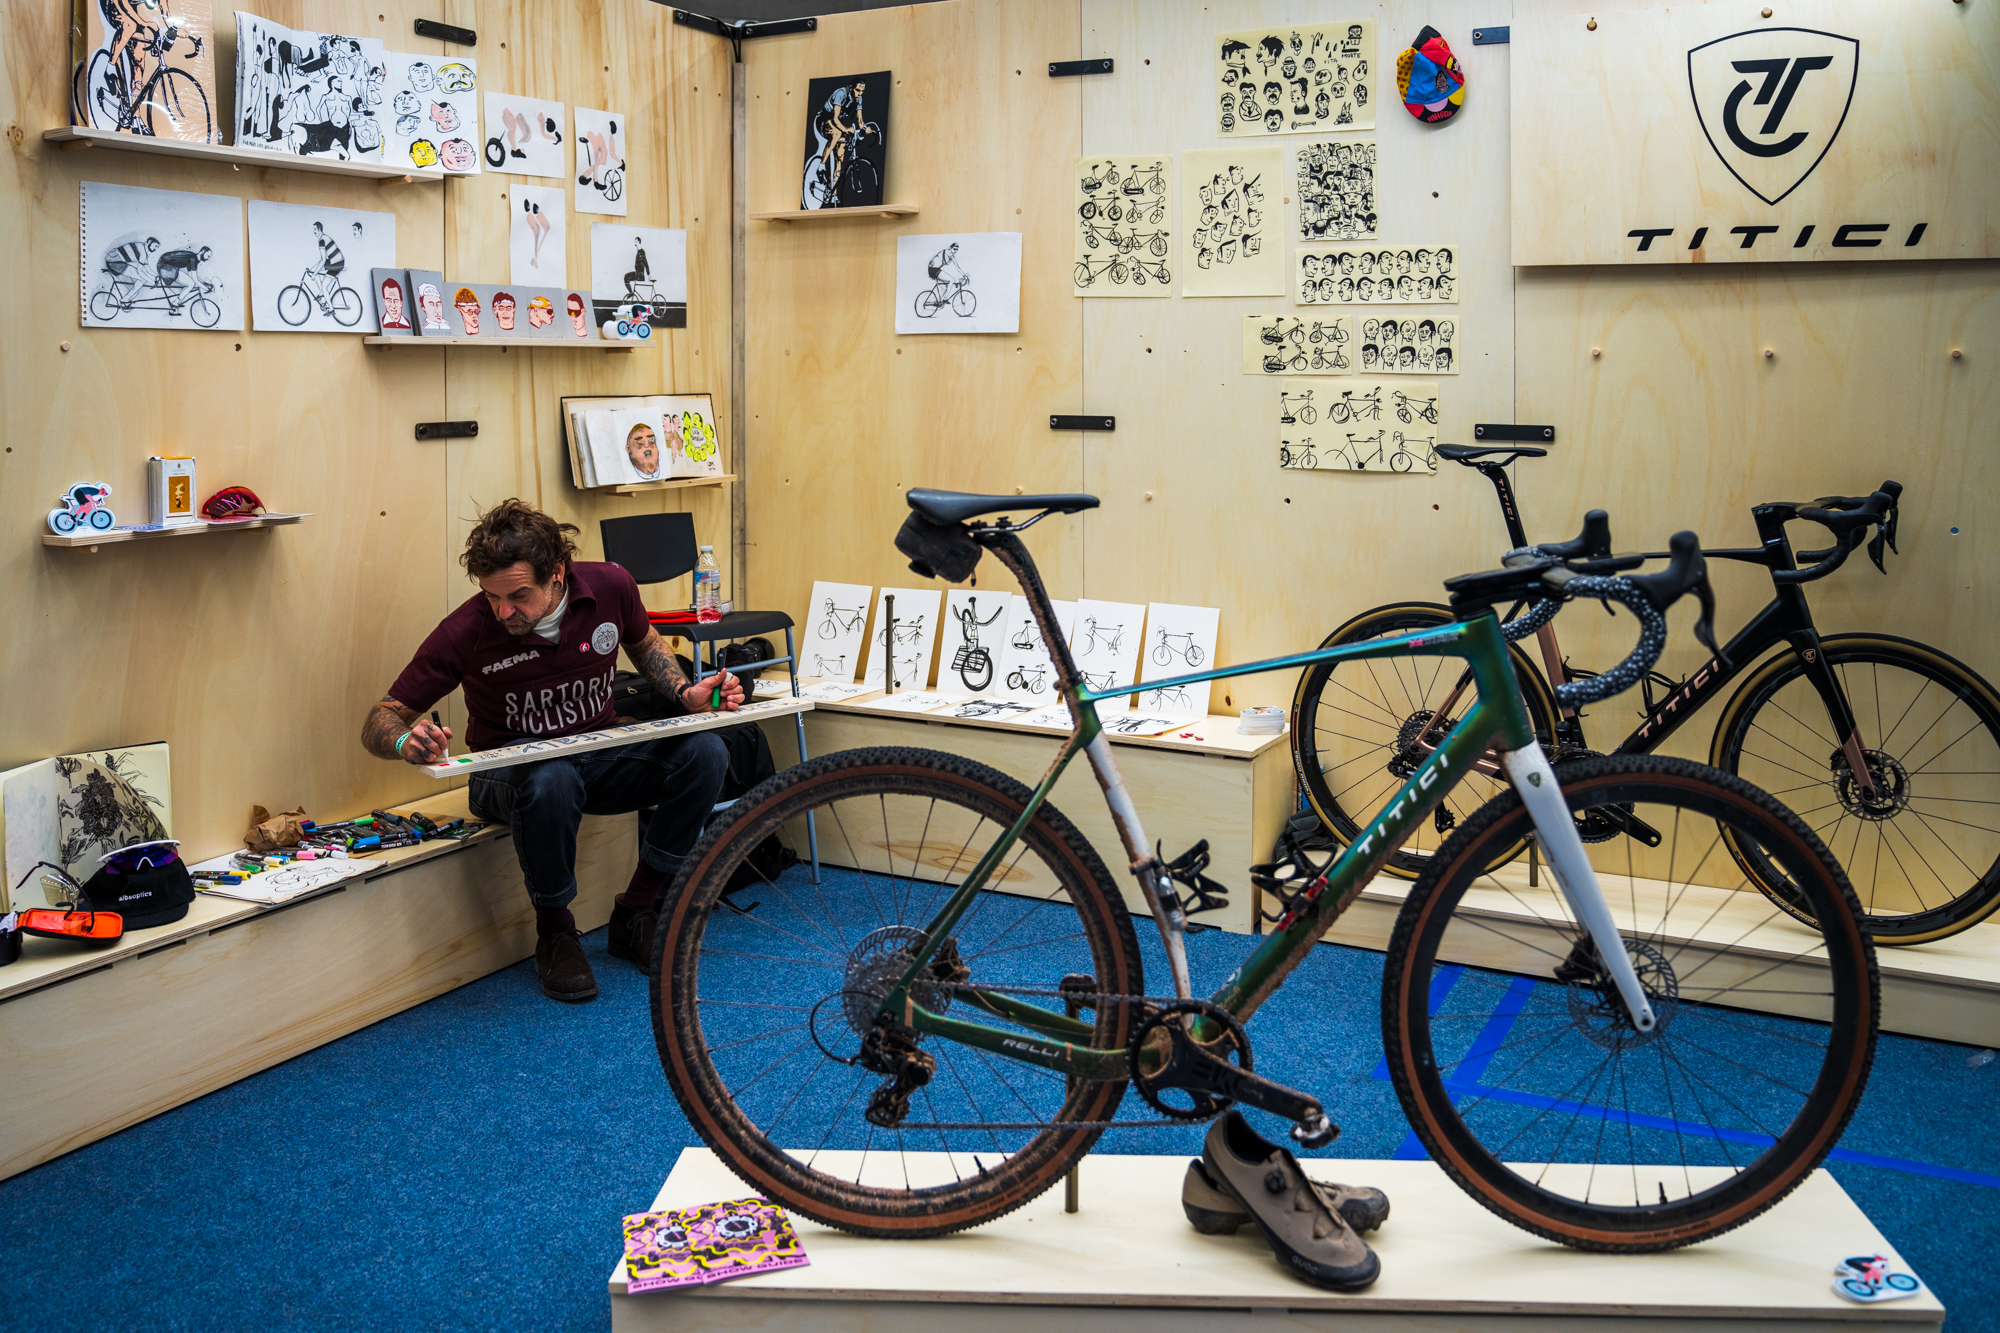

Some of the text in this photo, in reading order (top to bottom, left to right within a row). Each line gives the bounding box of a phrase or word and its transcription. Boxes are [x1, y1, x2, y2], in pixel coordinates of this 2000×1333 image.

[1627, 222, 1928, 252] TITICI
[1498, 478, 1515, 521] TITICI
[481, 650, 540, 675] FAEMA
[505, 666, 615, 715] SARTORIA
[1637, 659, 1720, 739] TITICI
[1357, 753, 1449, 855] TITICI
[118, 891, 152, 902] albaoptics
[1002, 1037, 1060, 1059] RELLI
[706, 1265, 753, 1280] SHOW
[757, 1258, 804, 1269] GUIDE
[632, 1277, 680, 1290] SHOW
